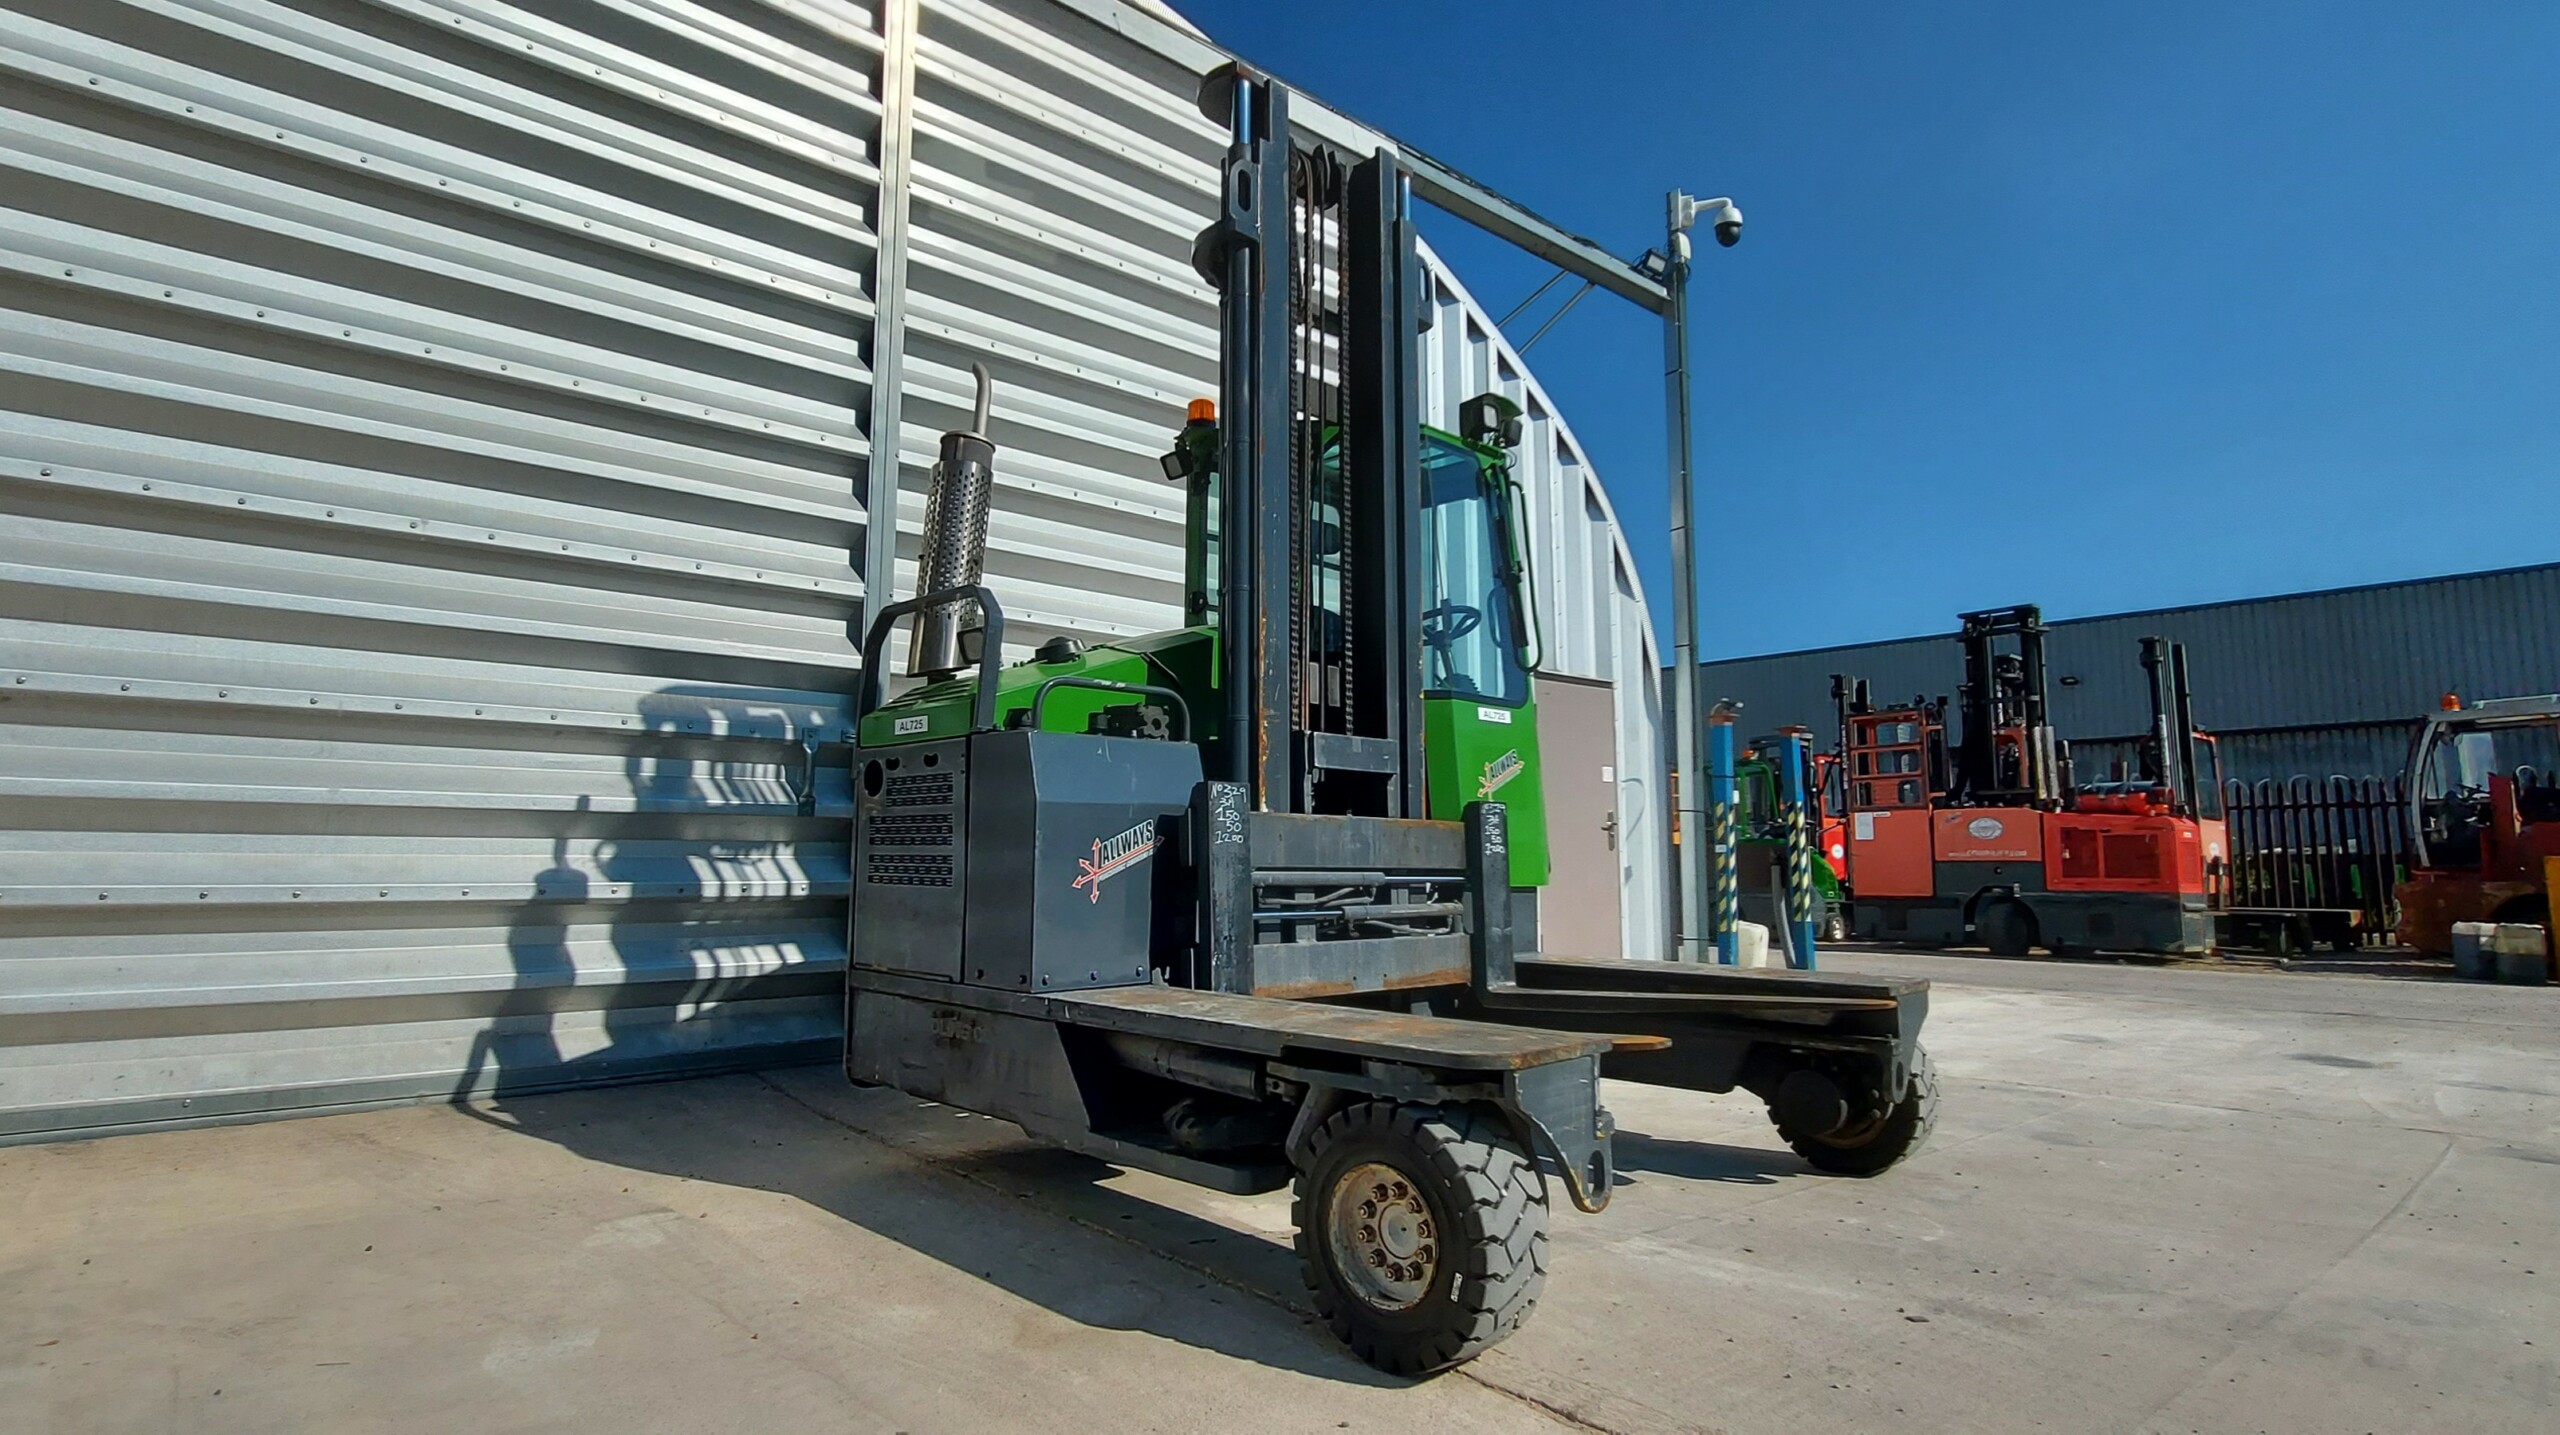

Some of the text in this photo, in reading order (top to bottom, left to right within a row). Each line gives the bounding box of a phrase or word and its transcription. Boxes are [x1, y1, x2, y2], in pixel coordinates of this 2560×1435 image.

[899, 719, 924, 732] AL725
[1215, 807, 1240, 821] 150
[1226, 820, 1242, 832] 50
[1101, 820, 1154, 866] ALLWAYS
[1215, 830, 1244, 844] 1200
